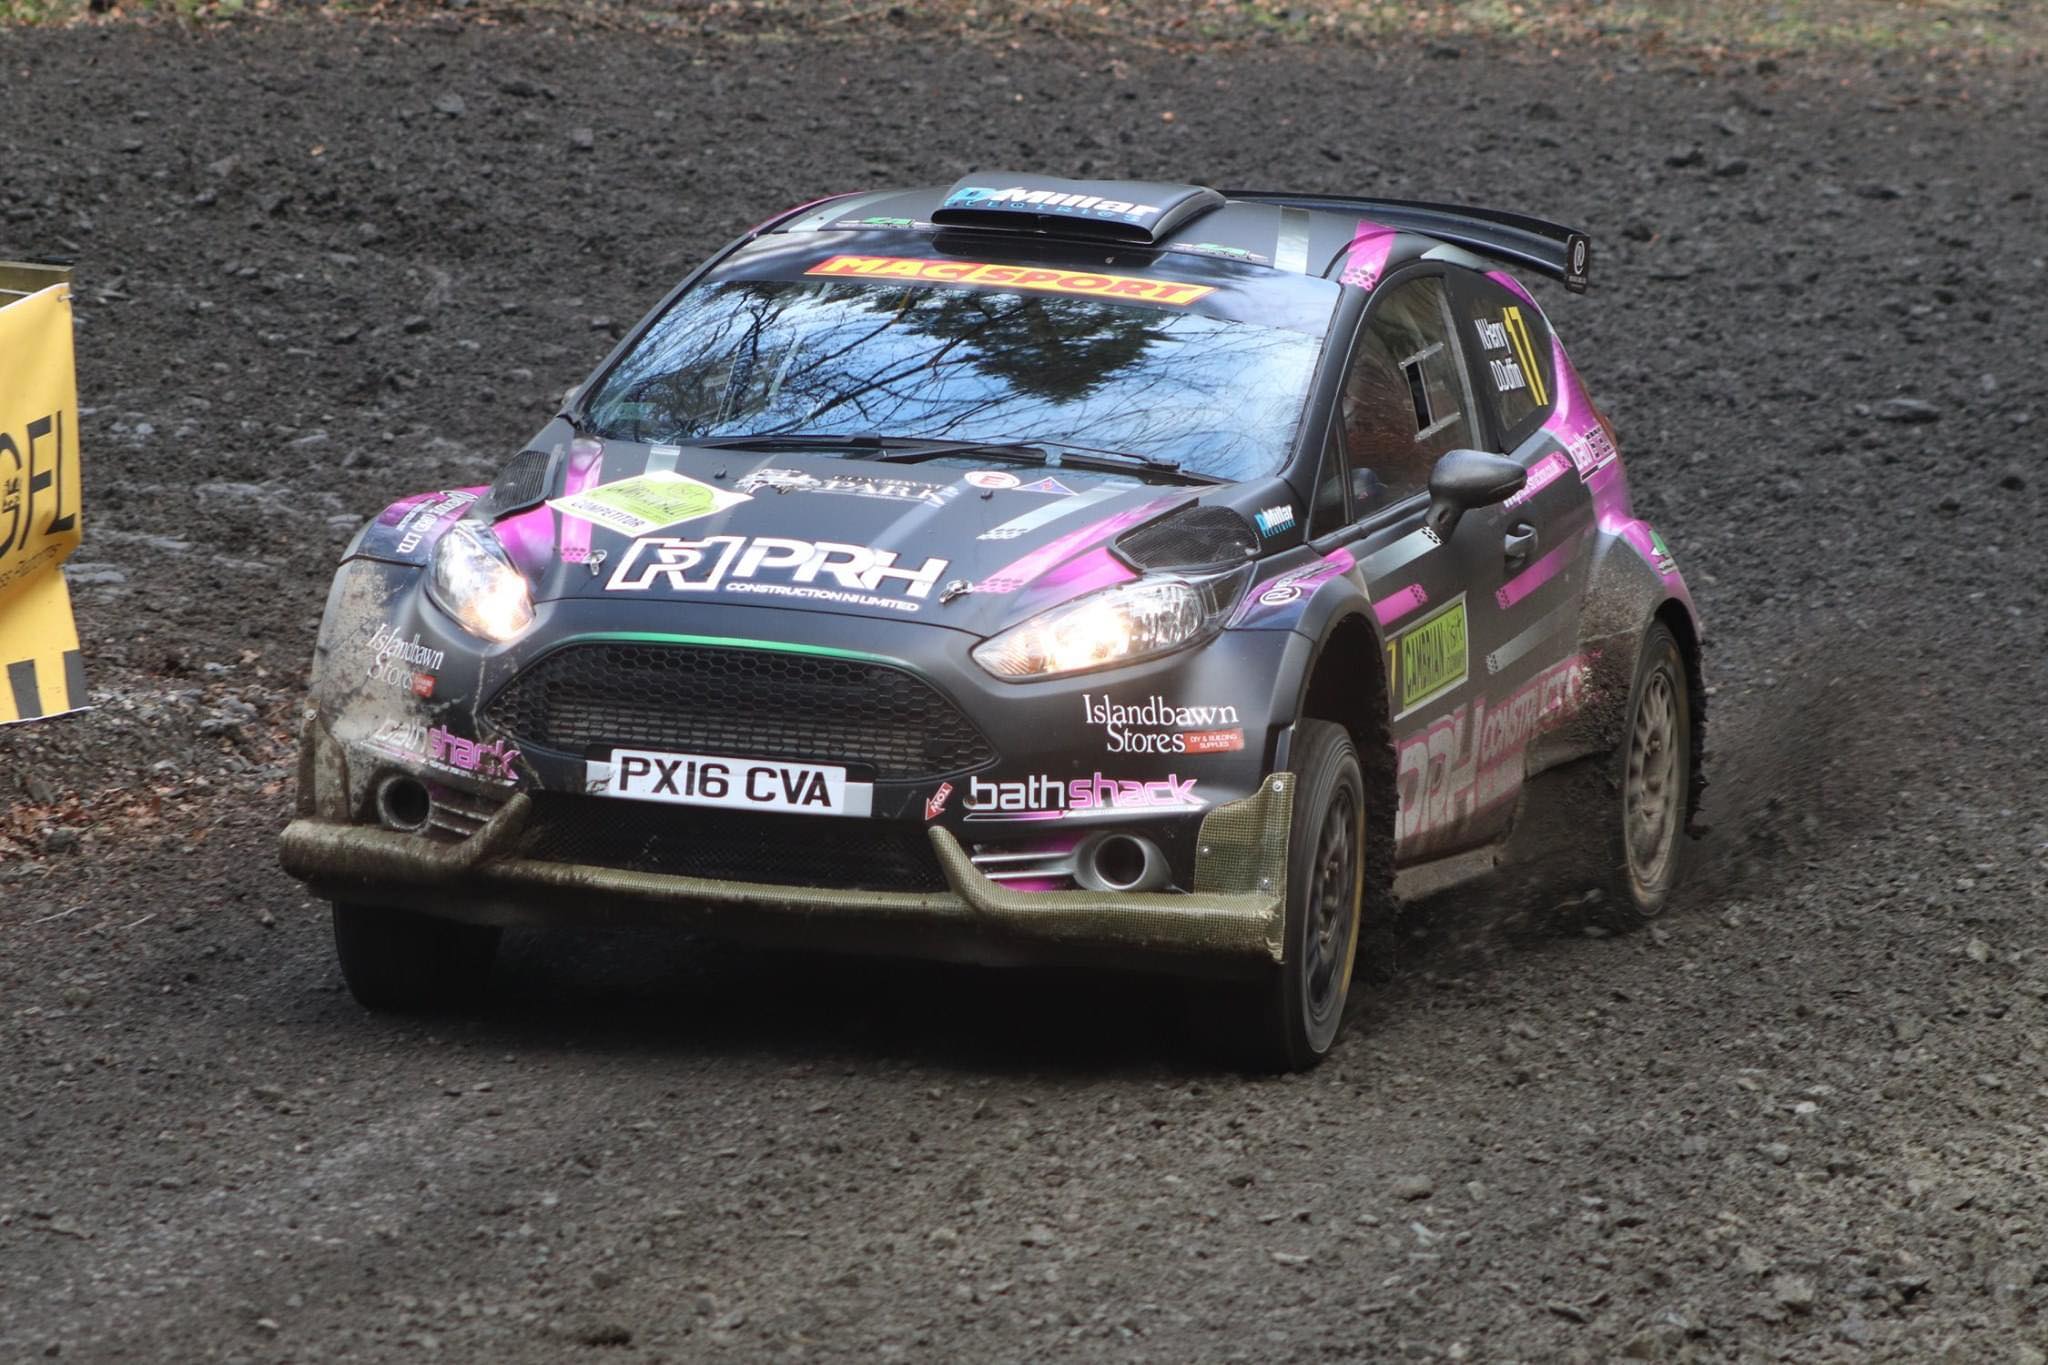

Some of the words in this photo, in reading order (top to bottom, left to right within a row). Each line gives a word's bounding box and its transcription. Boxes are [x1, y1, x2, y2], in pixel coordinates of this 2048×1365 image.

[732, 537, 949, 599] PRH
[725, 582, 843, 601] CONSTRUCTION
[859, 595, 920, 612] LIMITED
[1083, 694, 1239, 727] Islandbawn
[1106, 720, 1186, 753] Stores
[619, 756, 731, 799] PX16
[745, 766, 832, 807] CVA
[931, 789, 950, 812] TOW
